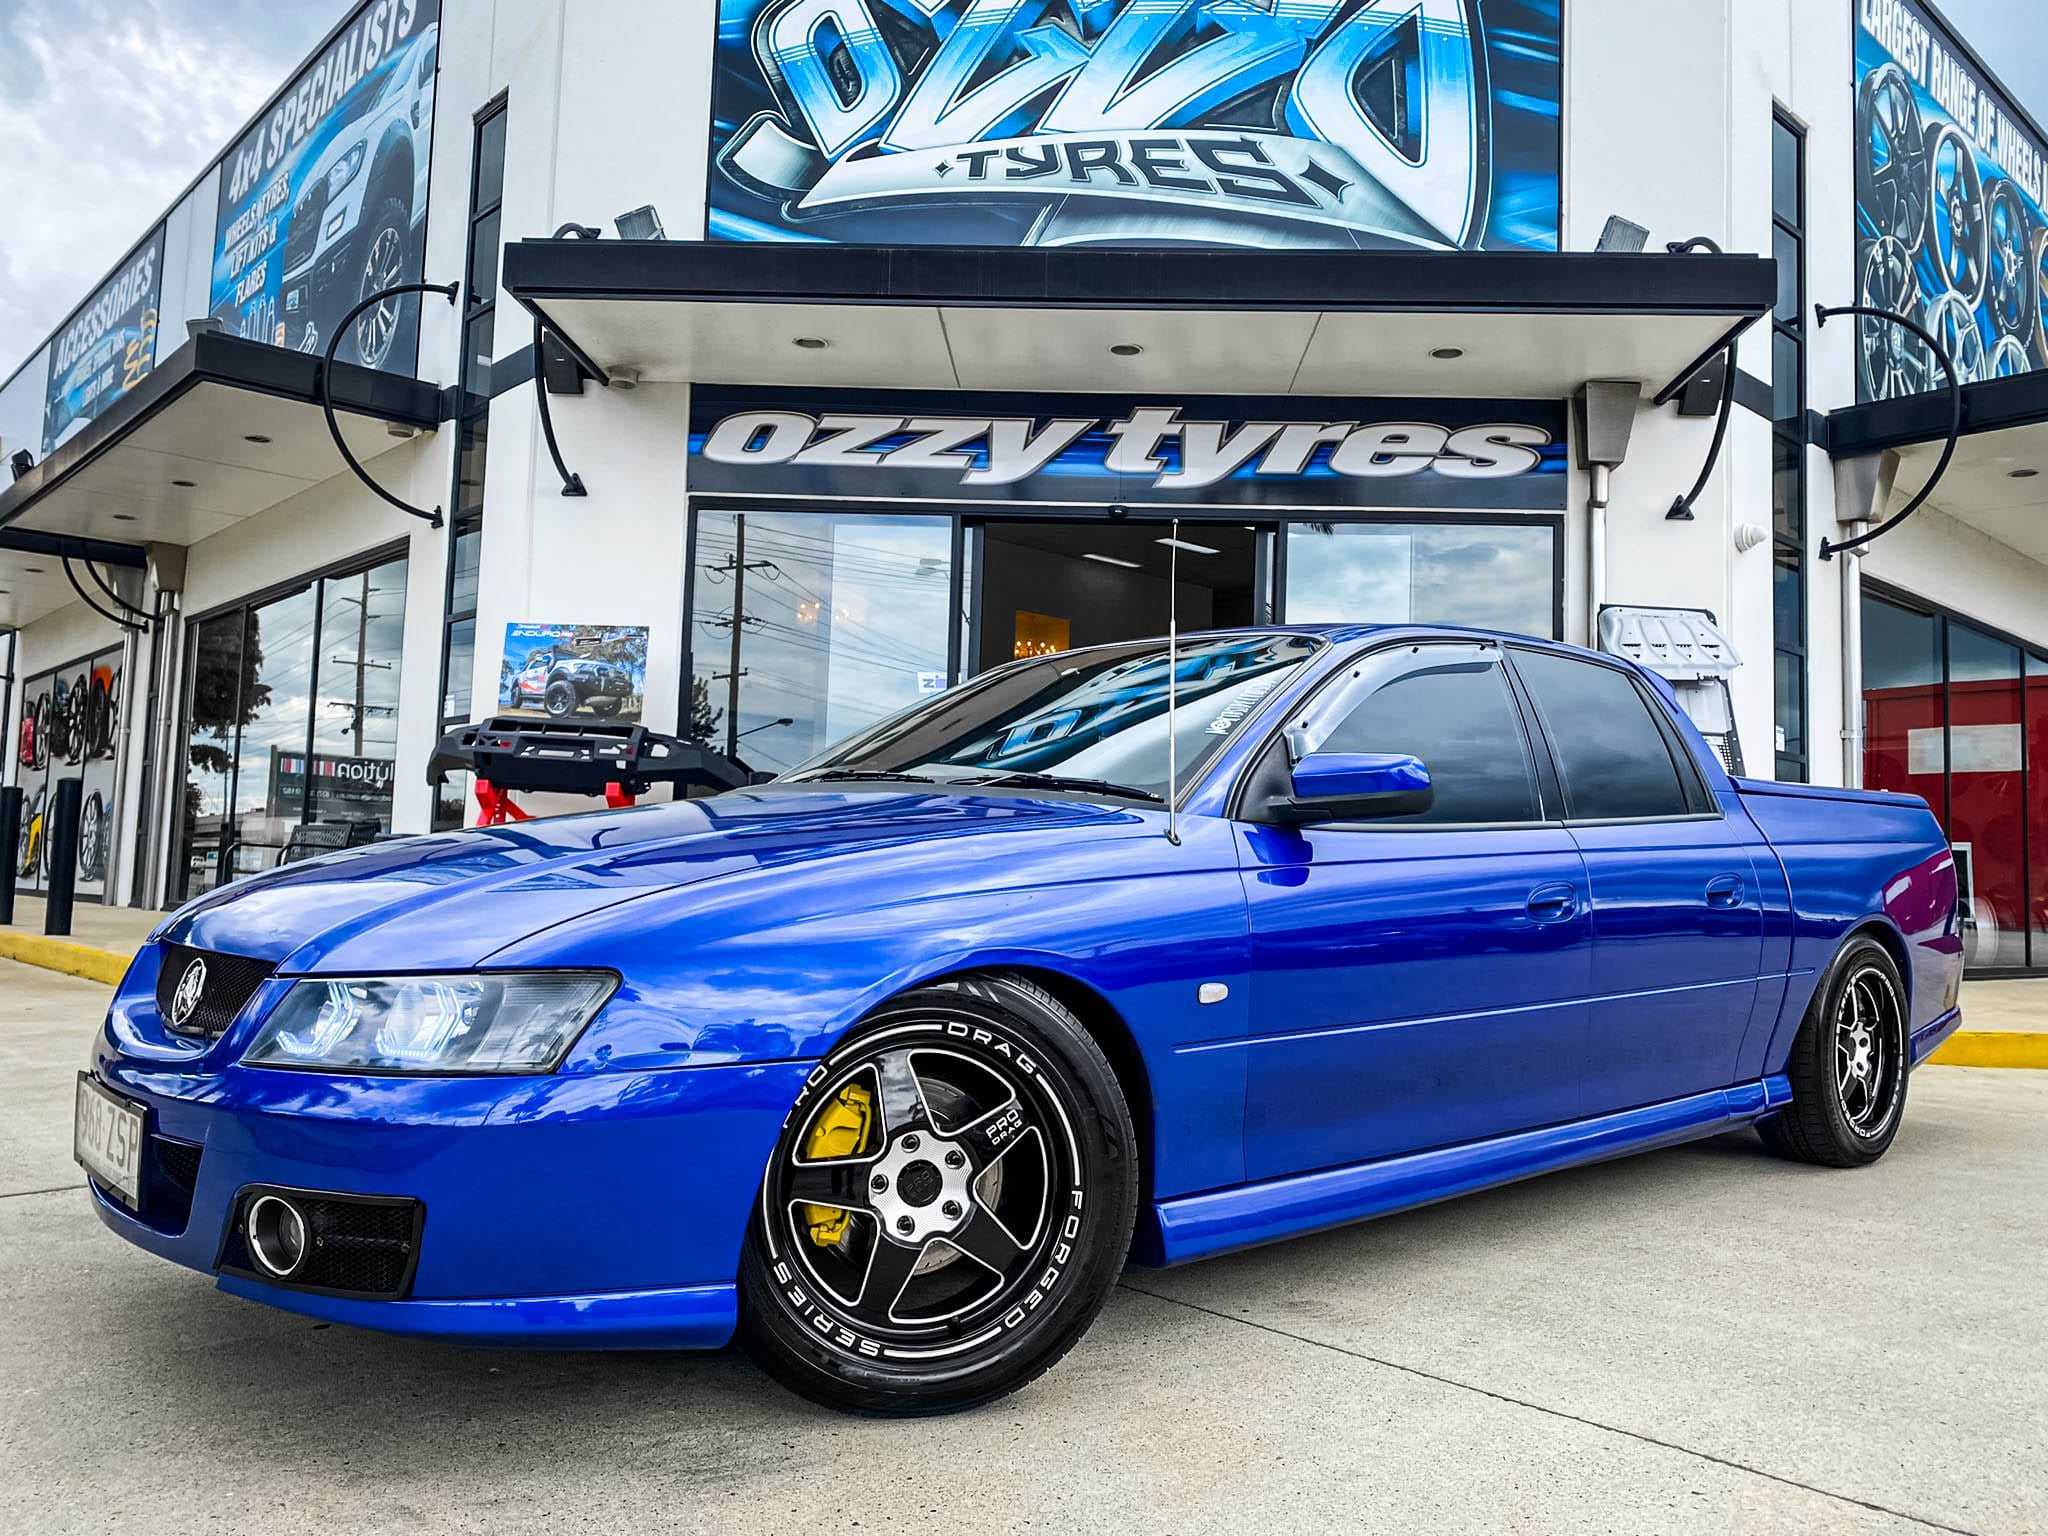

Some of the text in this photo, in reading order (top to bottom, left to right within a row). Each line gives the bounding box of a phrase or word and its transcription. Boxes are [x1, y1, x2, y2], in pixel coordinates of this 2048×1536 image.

[267, 0, 416, 170] SPECIALISTS
[1861, 0, 1930, 89] LARGEST
[1931, 37, 1977, 142] RANGE
[1977, 89, 1996, 157] OF
[1996, 108, 2042, 208] WHEELS
[955, 136, 1323, 209] TYRES
[234, 260, 268, 308] FLARES
[702, 406, 1553, 488] ozzy tyres
[946, 1021, 1039, 1074] DRAG
[106, 1104, 139, 1172] ZSP
[986, 1109, 1019, 1139] PRO
[992, 1119, 1023, 1145] DRAG
[1003, 1189, 1083, 1330] FORGED
[773, 1262, 881, 1357] SERIES
